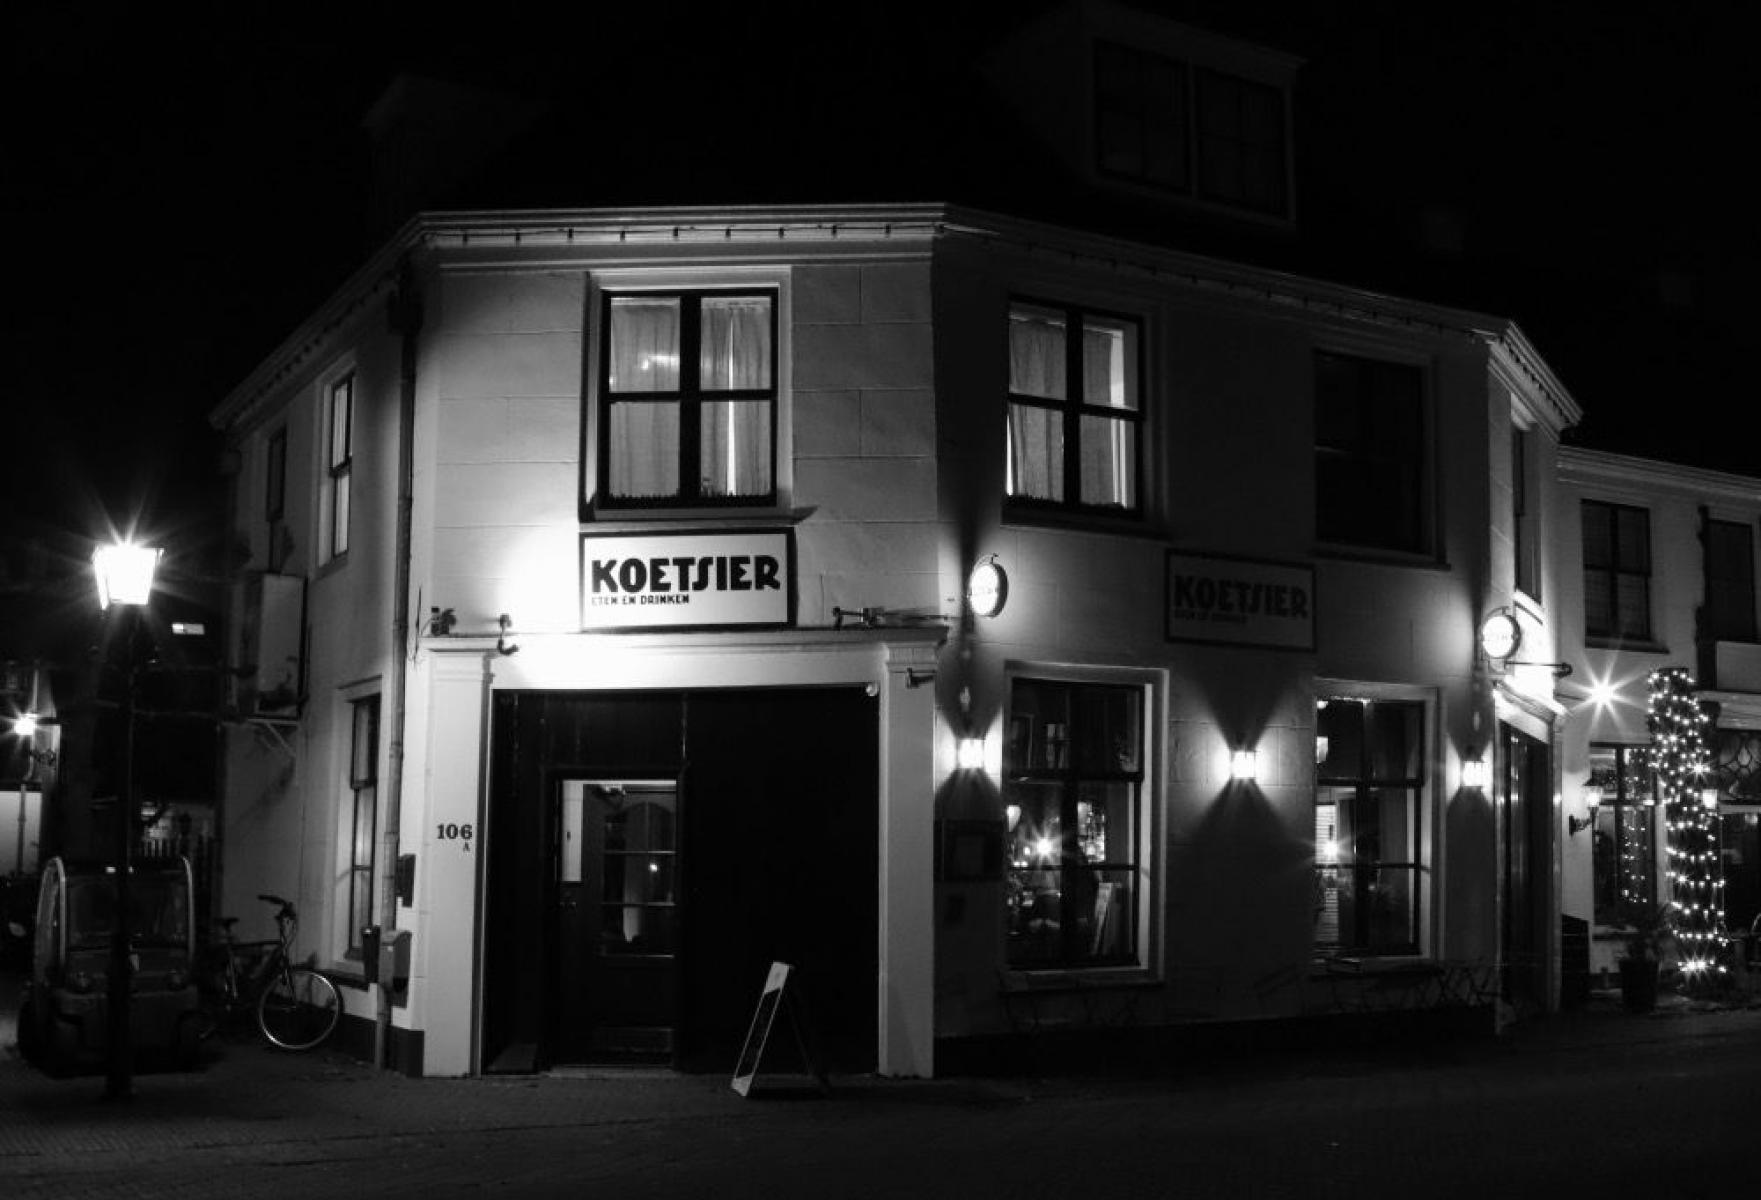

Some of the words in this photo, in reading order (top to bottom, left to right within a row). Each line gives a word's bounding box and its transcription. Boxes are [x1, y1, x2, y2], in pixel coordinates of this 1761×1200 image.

[592, 555, 780, 592] KOETSIER
[623, 595, 636, 605] EN
[641, 593, 689, 604] DRINKEN
[1174, 576, 1307, 618] KOETSIER
[438, 824, 472, 839] 106
